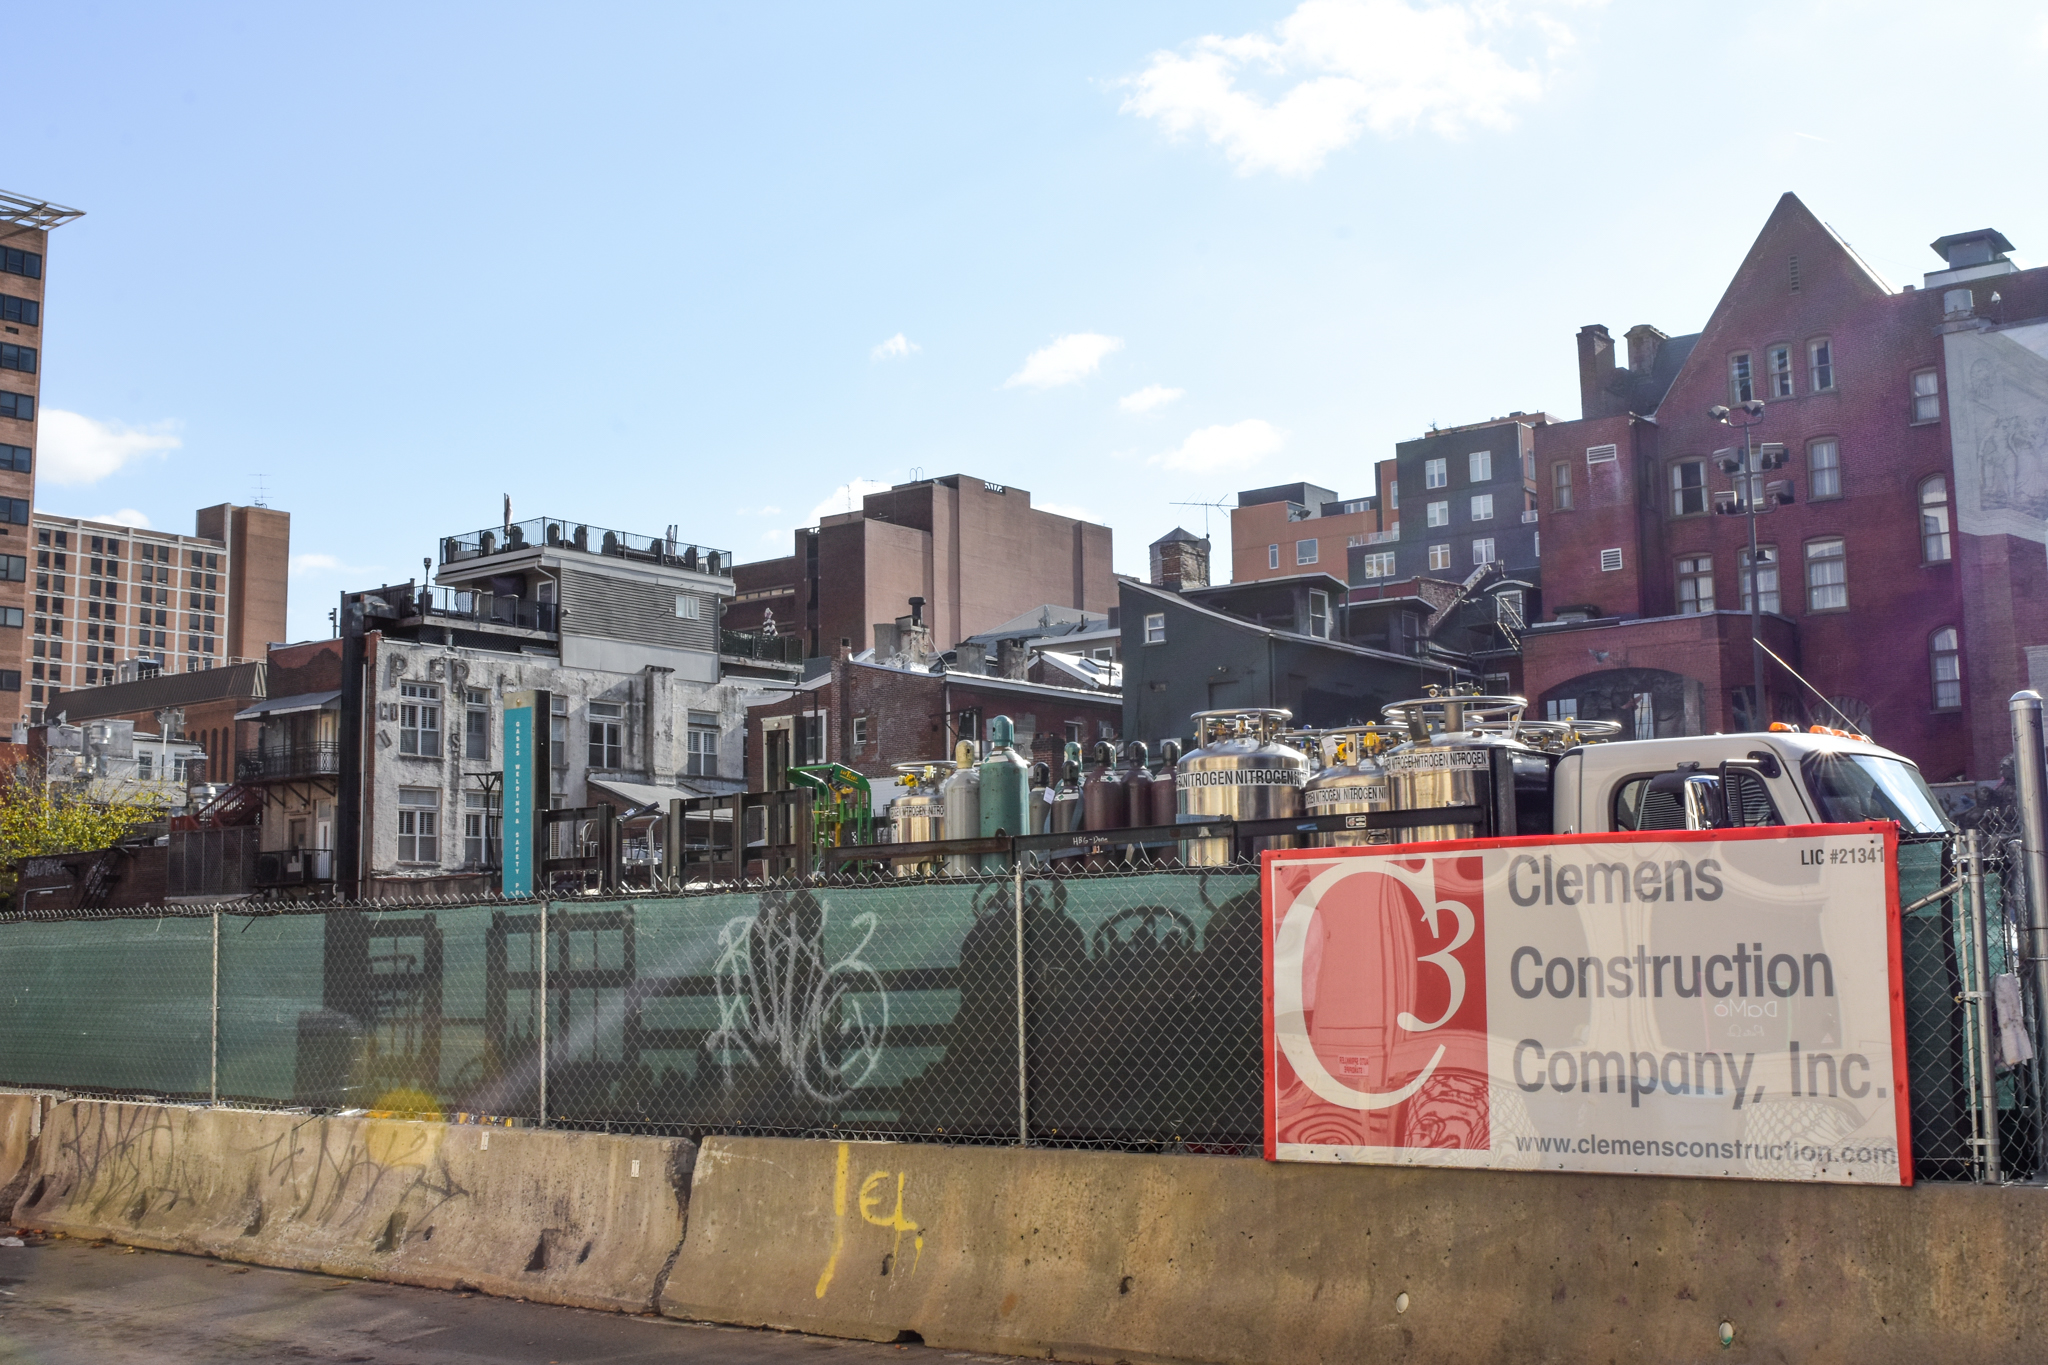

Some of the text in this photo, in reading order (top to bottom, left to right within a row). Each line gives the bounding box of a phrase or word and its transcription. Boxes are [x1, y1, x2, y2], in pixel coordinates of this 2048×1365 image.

[1449, 751, 1487, 766] NITROGEN
[1184, 770, 1233, 787] NITROGEN
[1235, 769, 1293, 785] NITROGEN
[1344, 787, 1377, 800] NITROGEN
[1801, 847, 1884, 865] LIC #21341
[1507, 853, 1724, 907] Clemens
[1510, 942, 1834, 999] Construction
[1513, 1038, 1887, 1110] Company, Inc.
[1515, 1134, 1897, 1165] www.clemensconstruction.com
